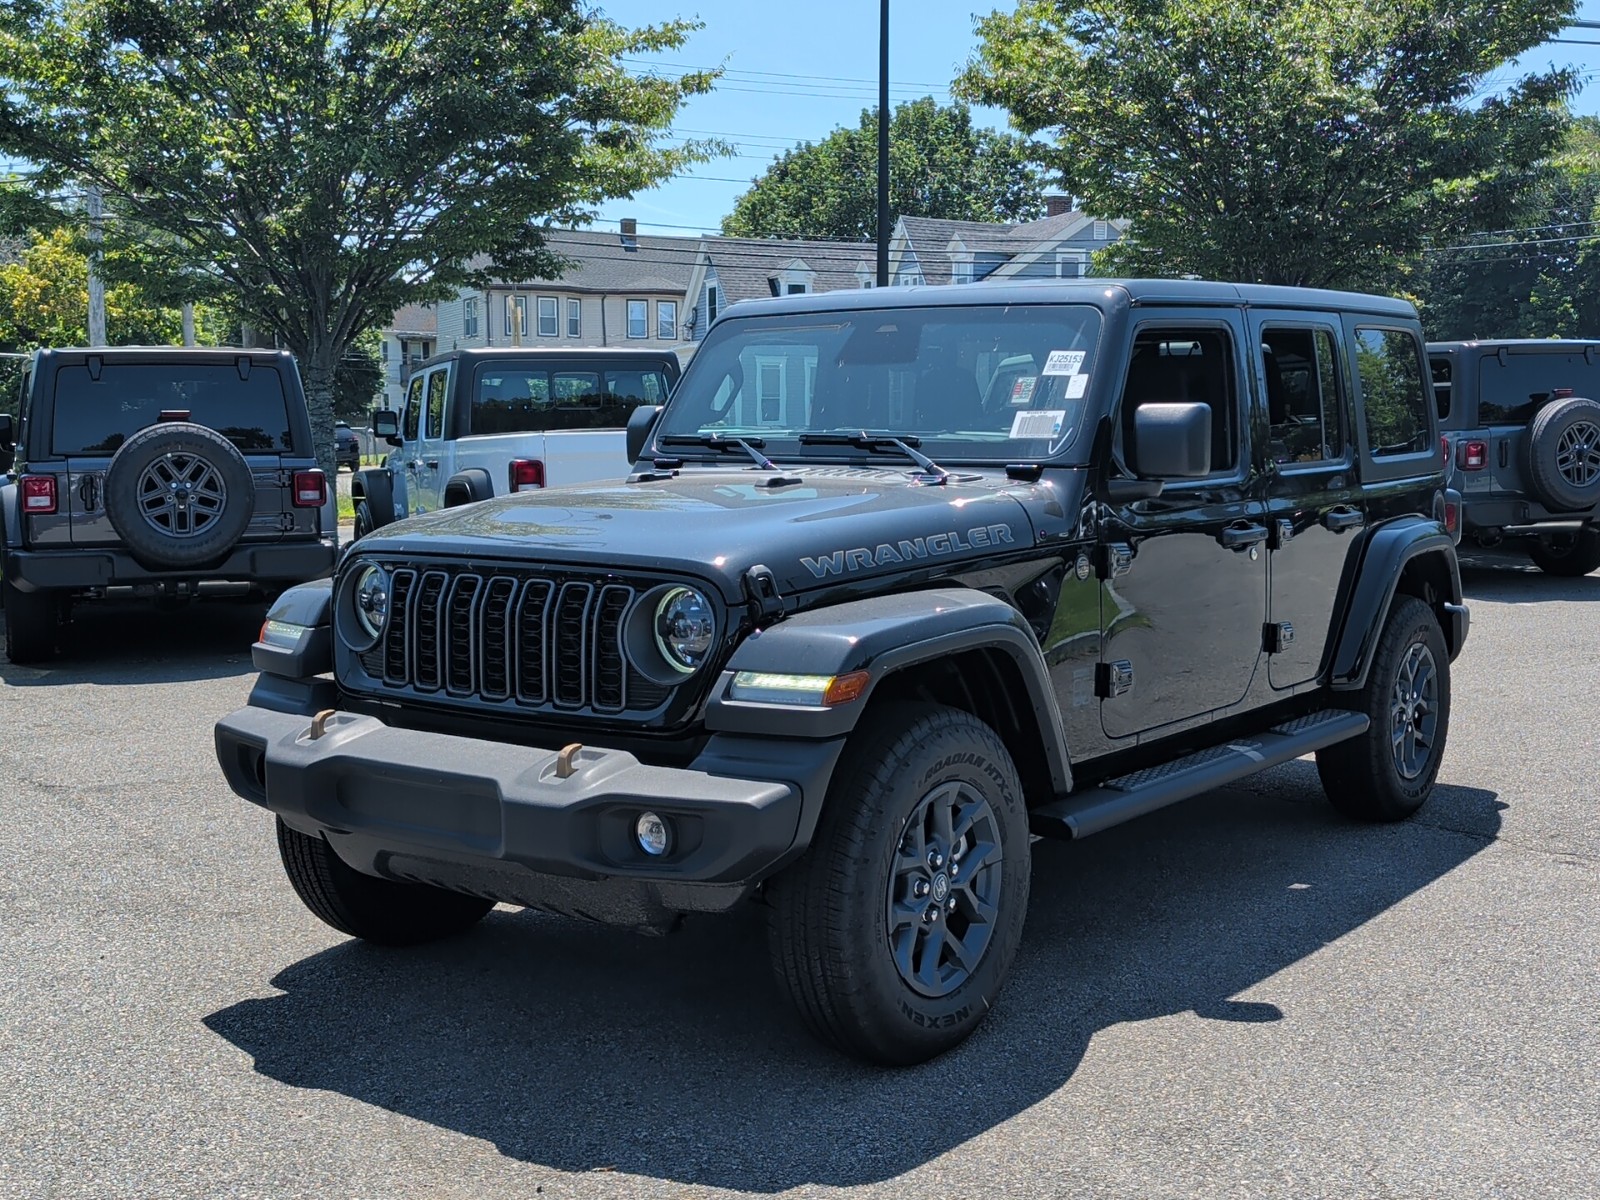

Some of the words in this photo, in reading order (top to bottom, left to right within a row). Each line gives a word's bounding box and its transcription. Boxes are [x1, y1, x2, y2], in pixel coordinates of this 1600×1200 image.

[1049, 354, 1083, 363] KJ25153
[800, 523, 1014, 578] WRANGLER
[984, 763, 1014, 806] HTX2
[901, 1000, 969, 1029] NEXEN
